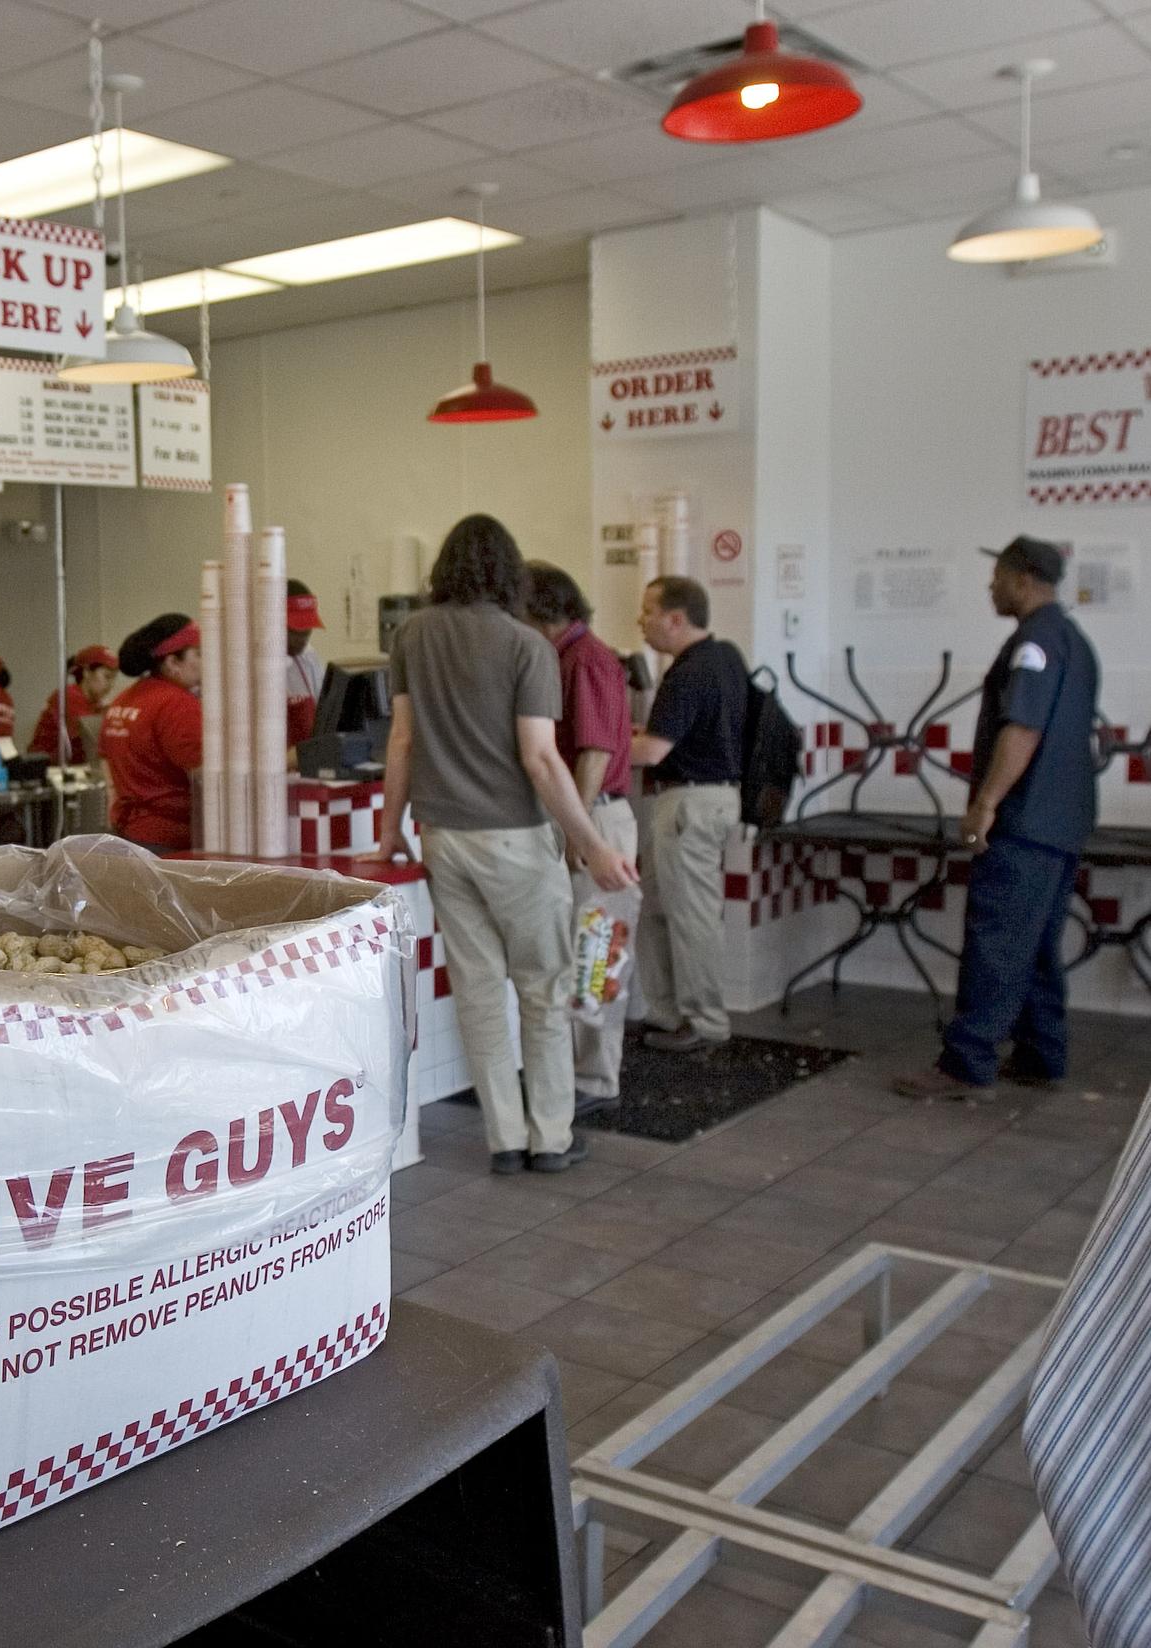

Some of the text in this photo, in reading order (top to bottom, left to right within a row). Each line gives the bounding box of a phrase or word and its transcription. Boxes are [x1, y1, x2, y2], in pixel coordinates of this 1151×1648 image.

[44, 254, 92, 291] UP
[610, 367, 715, 401] ORDER
[627, 403, 699, 428] HERE
[1035, 408, 1144, 458] BEST
[2, 1341, 62, 1383] NOT
[69, 1300, 178, 1360] REMOVE
[185, 1257, 285, 1317] PEANUTS
[290, 1228, 343, 1273] FROM
[346, 1196, 386, 1243] STORE
[9, 1274, 144, 1340] POSSIBLE
[150, 1231, 264, 1295] ALLERGIC
